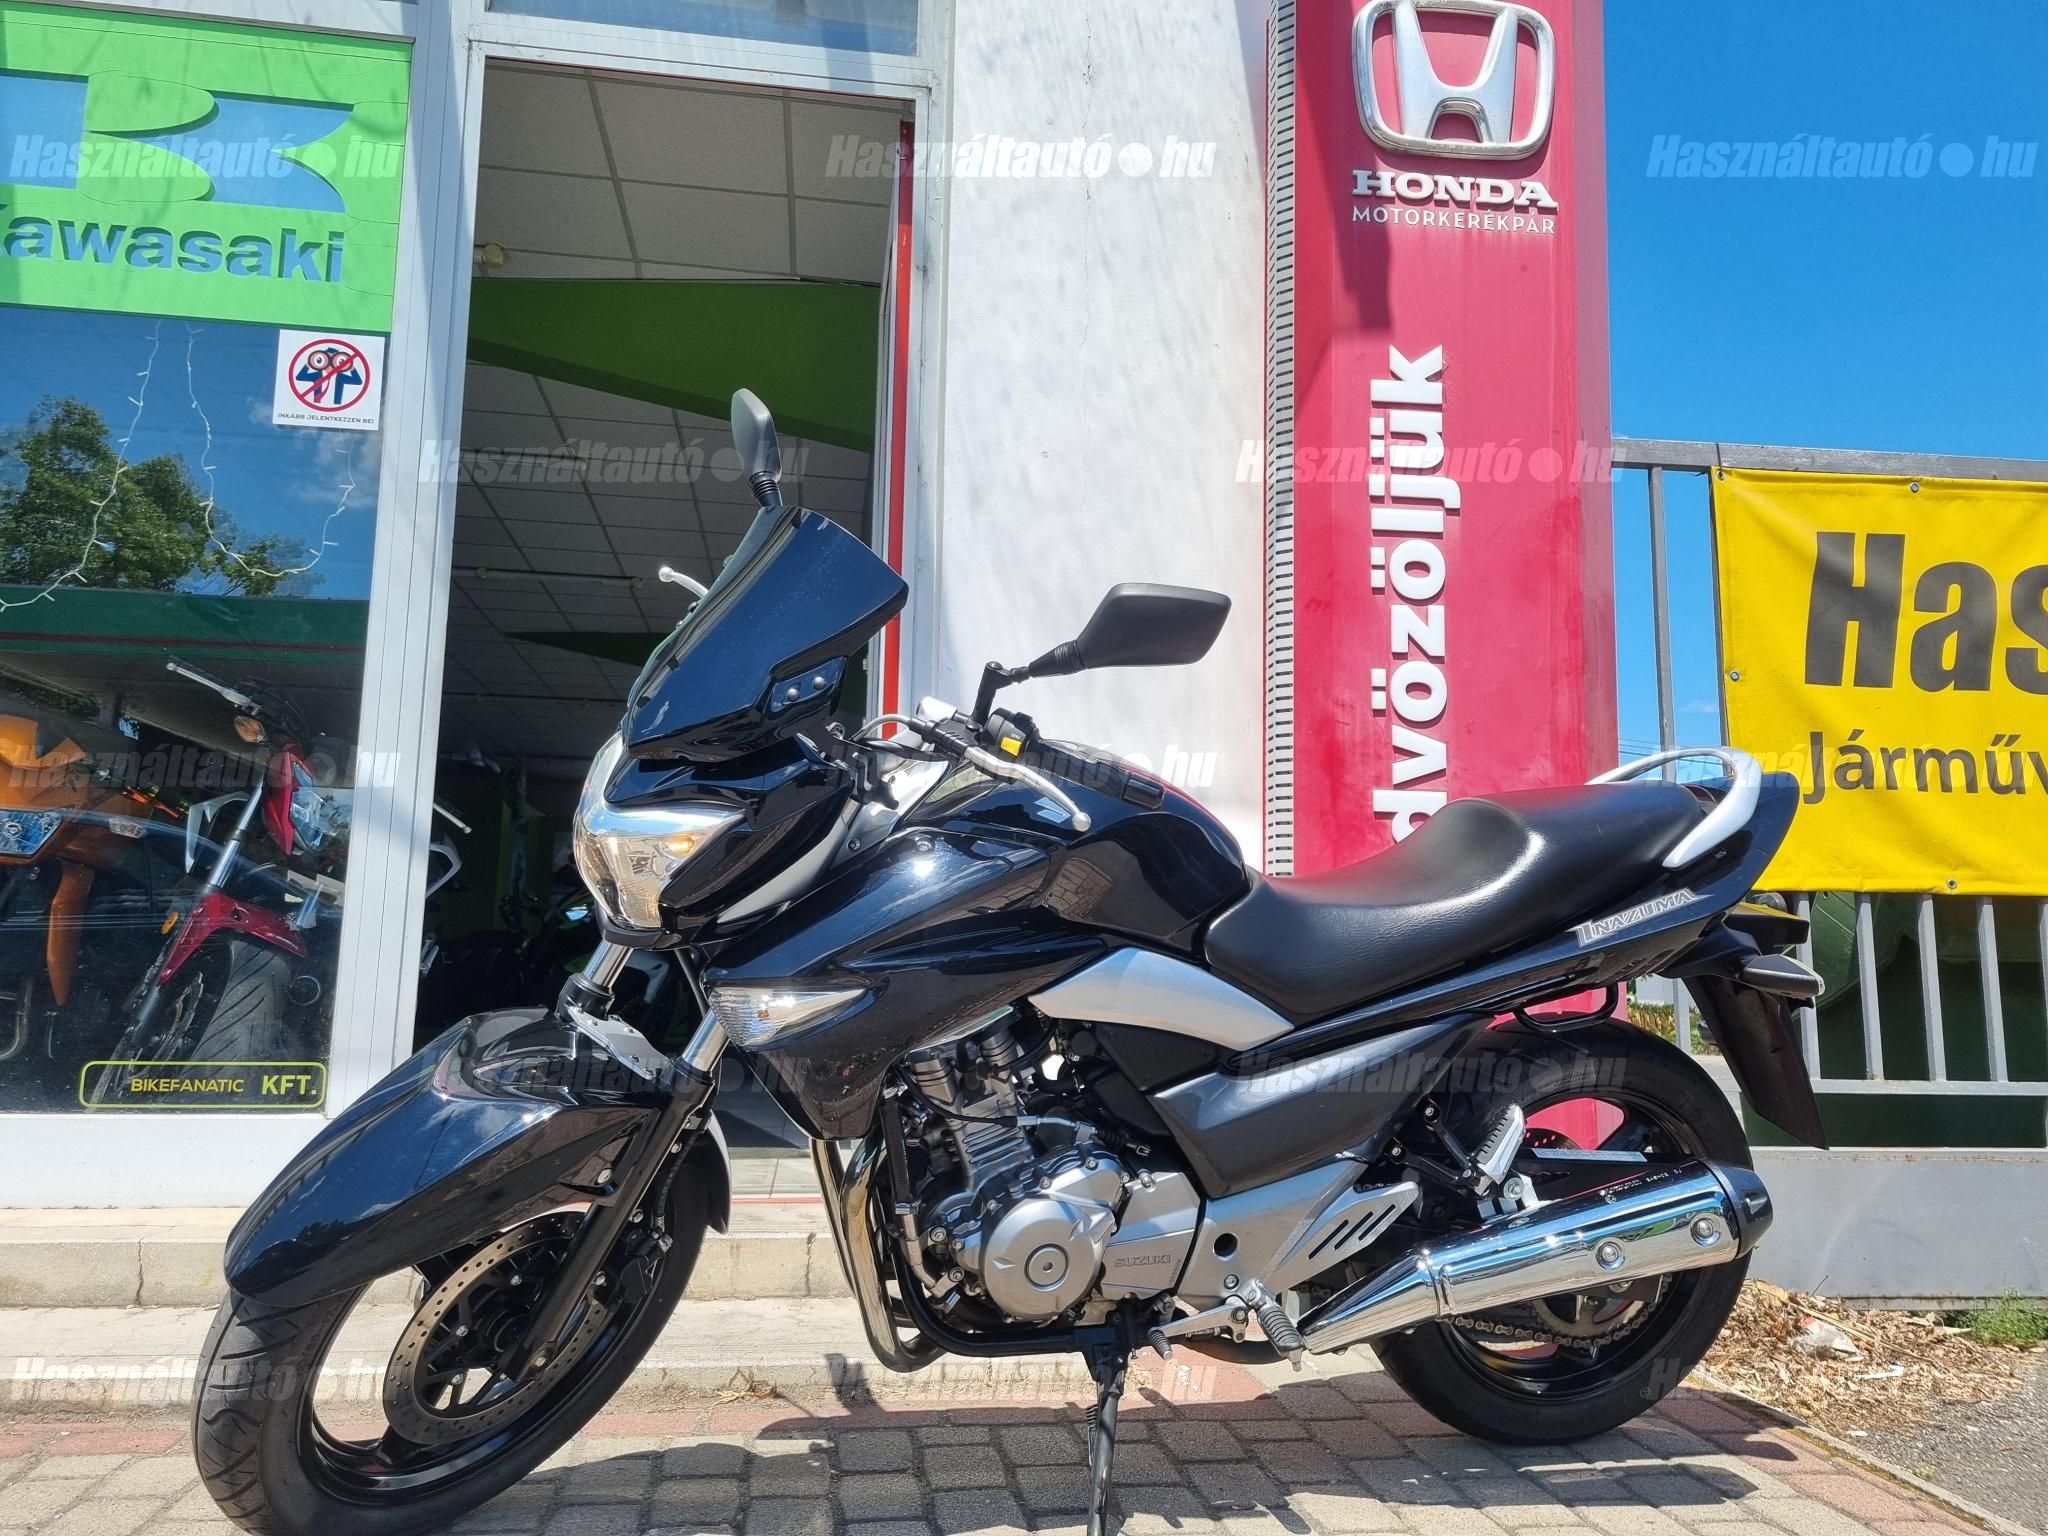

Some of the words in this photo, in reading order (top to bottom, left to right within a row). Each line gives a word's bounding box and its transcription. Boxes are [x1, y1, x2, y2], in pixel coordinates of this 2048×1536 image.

[1352, 169, 1559, 209] HONDA
[1352, 206, 1554, 234] MOTORKERÉKPÁR
[0, 203, 345, 284] awasaki
[278, 412, 305, 420] INKÁBB
[306, 415, 361, 424] JELENTKEZZEN
[1369, 344, 1461, 844] dvözöljük
[1568, 887, 1699, 948] INAZUMA
[131, 1079, 244, 1093] BIKEFANATIC
[262, 1075, 317, 1095] KFT.
[1114, 1254, 1171, 1268] SUZUKI
